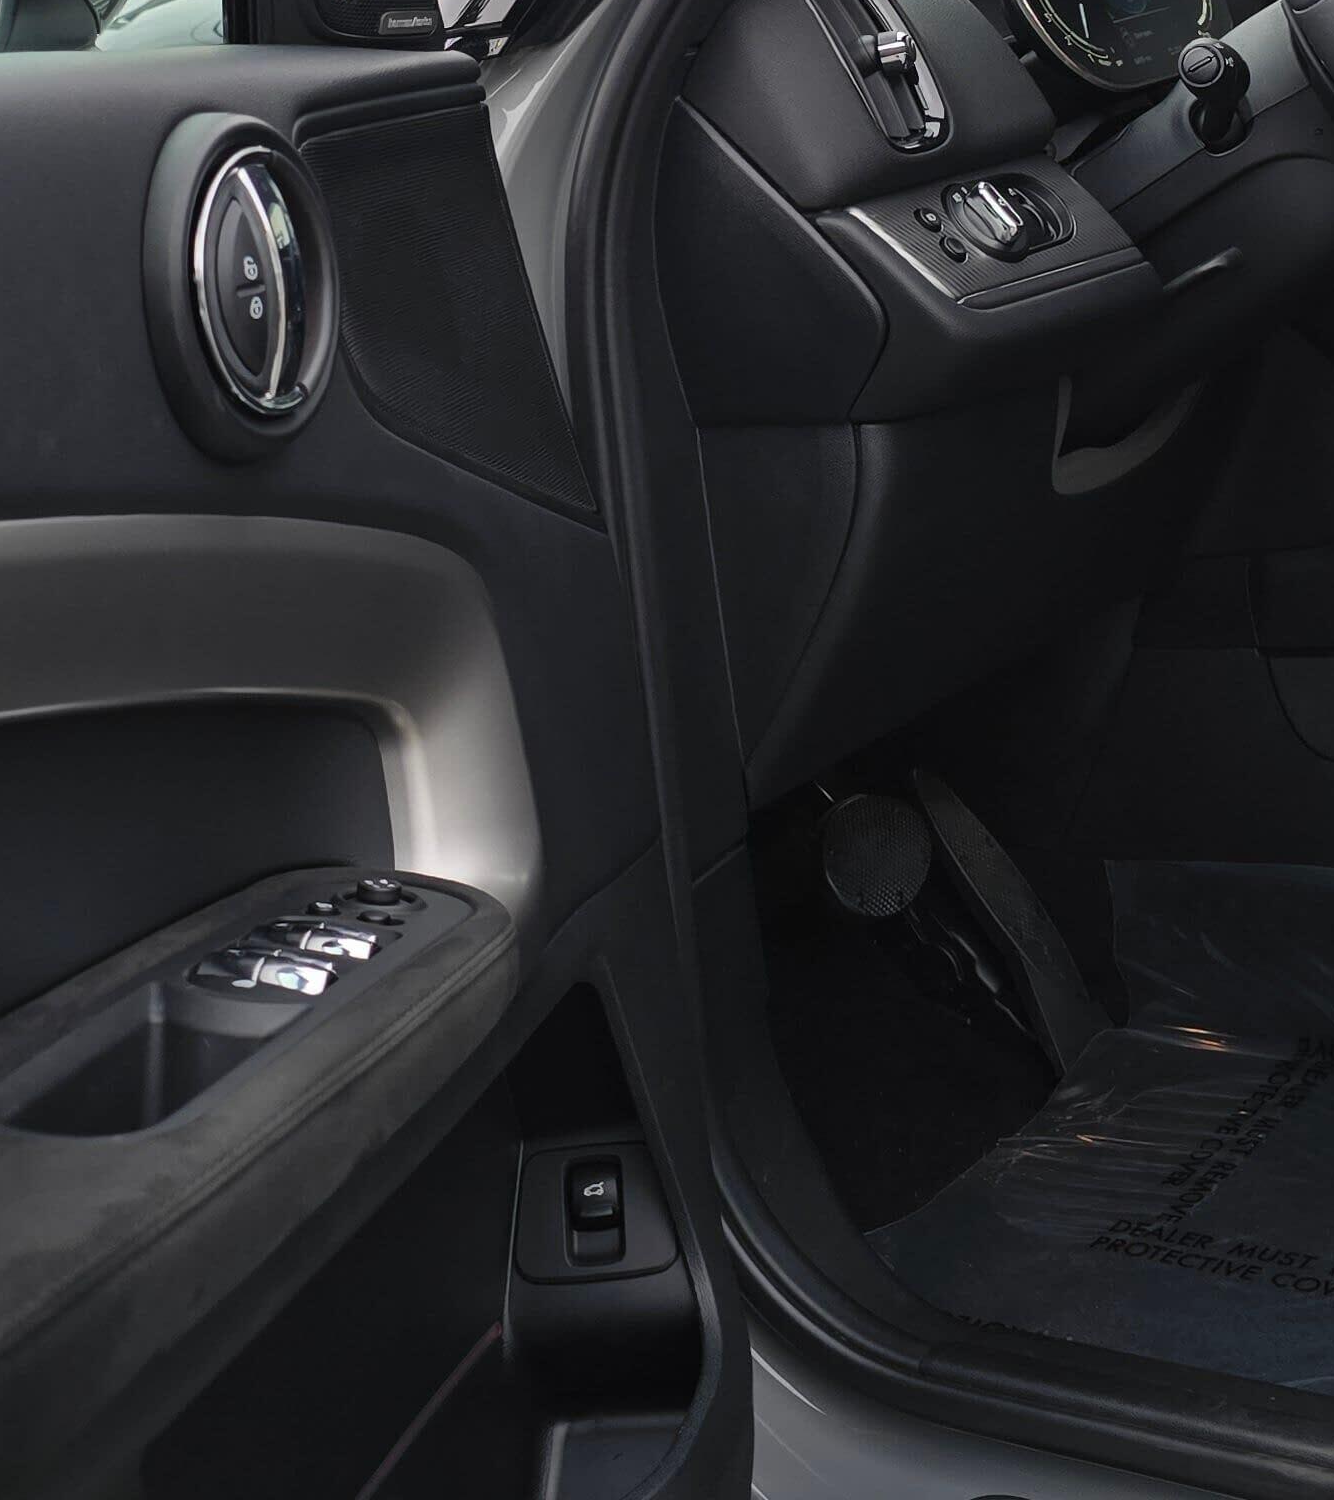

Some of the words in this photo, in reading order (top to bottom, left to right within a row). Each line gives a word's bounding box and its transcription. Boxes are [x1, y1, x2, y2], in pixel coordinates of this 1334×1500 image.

[1088, 1235, 1264, 1282] PROTECTIVE
[1108, 1218, 1214, 1251] DEALER
[1226, 1241, 1319, 1270] MUST
